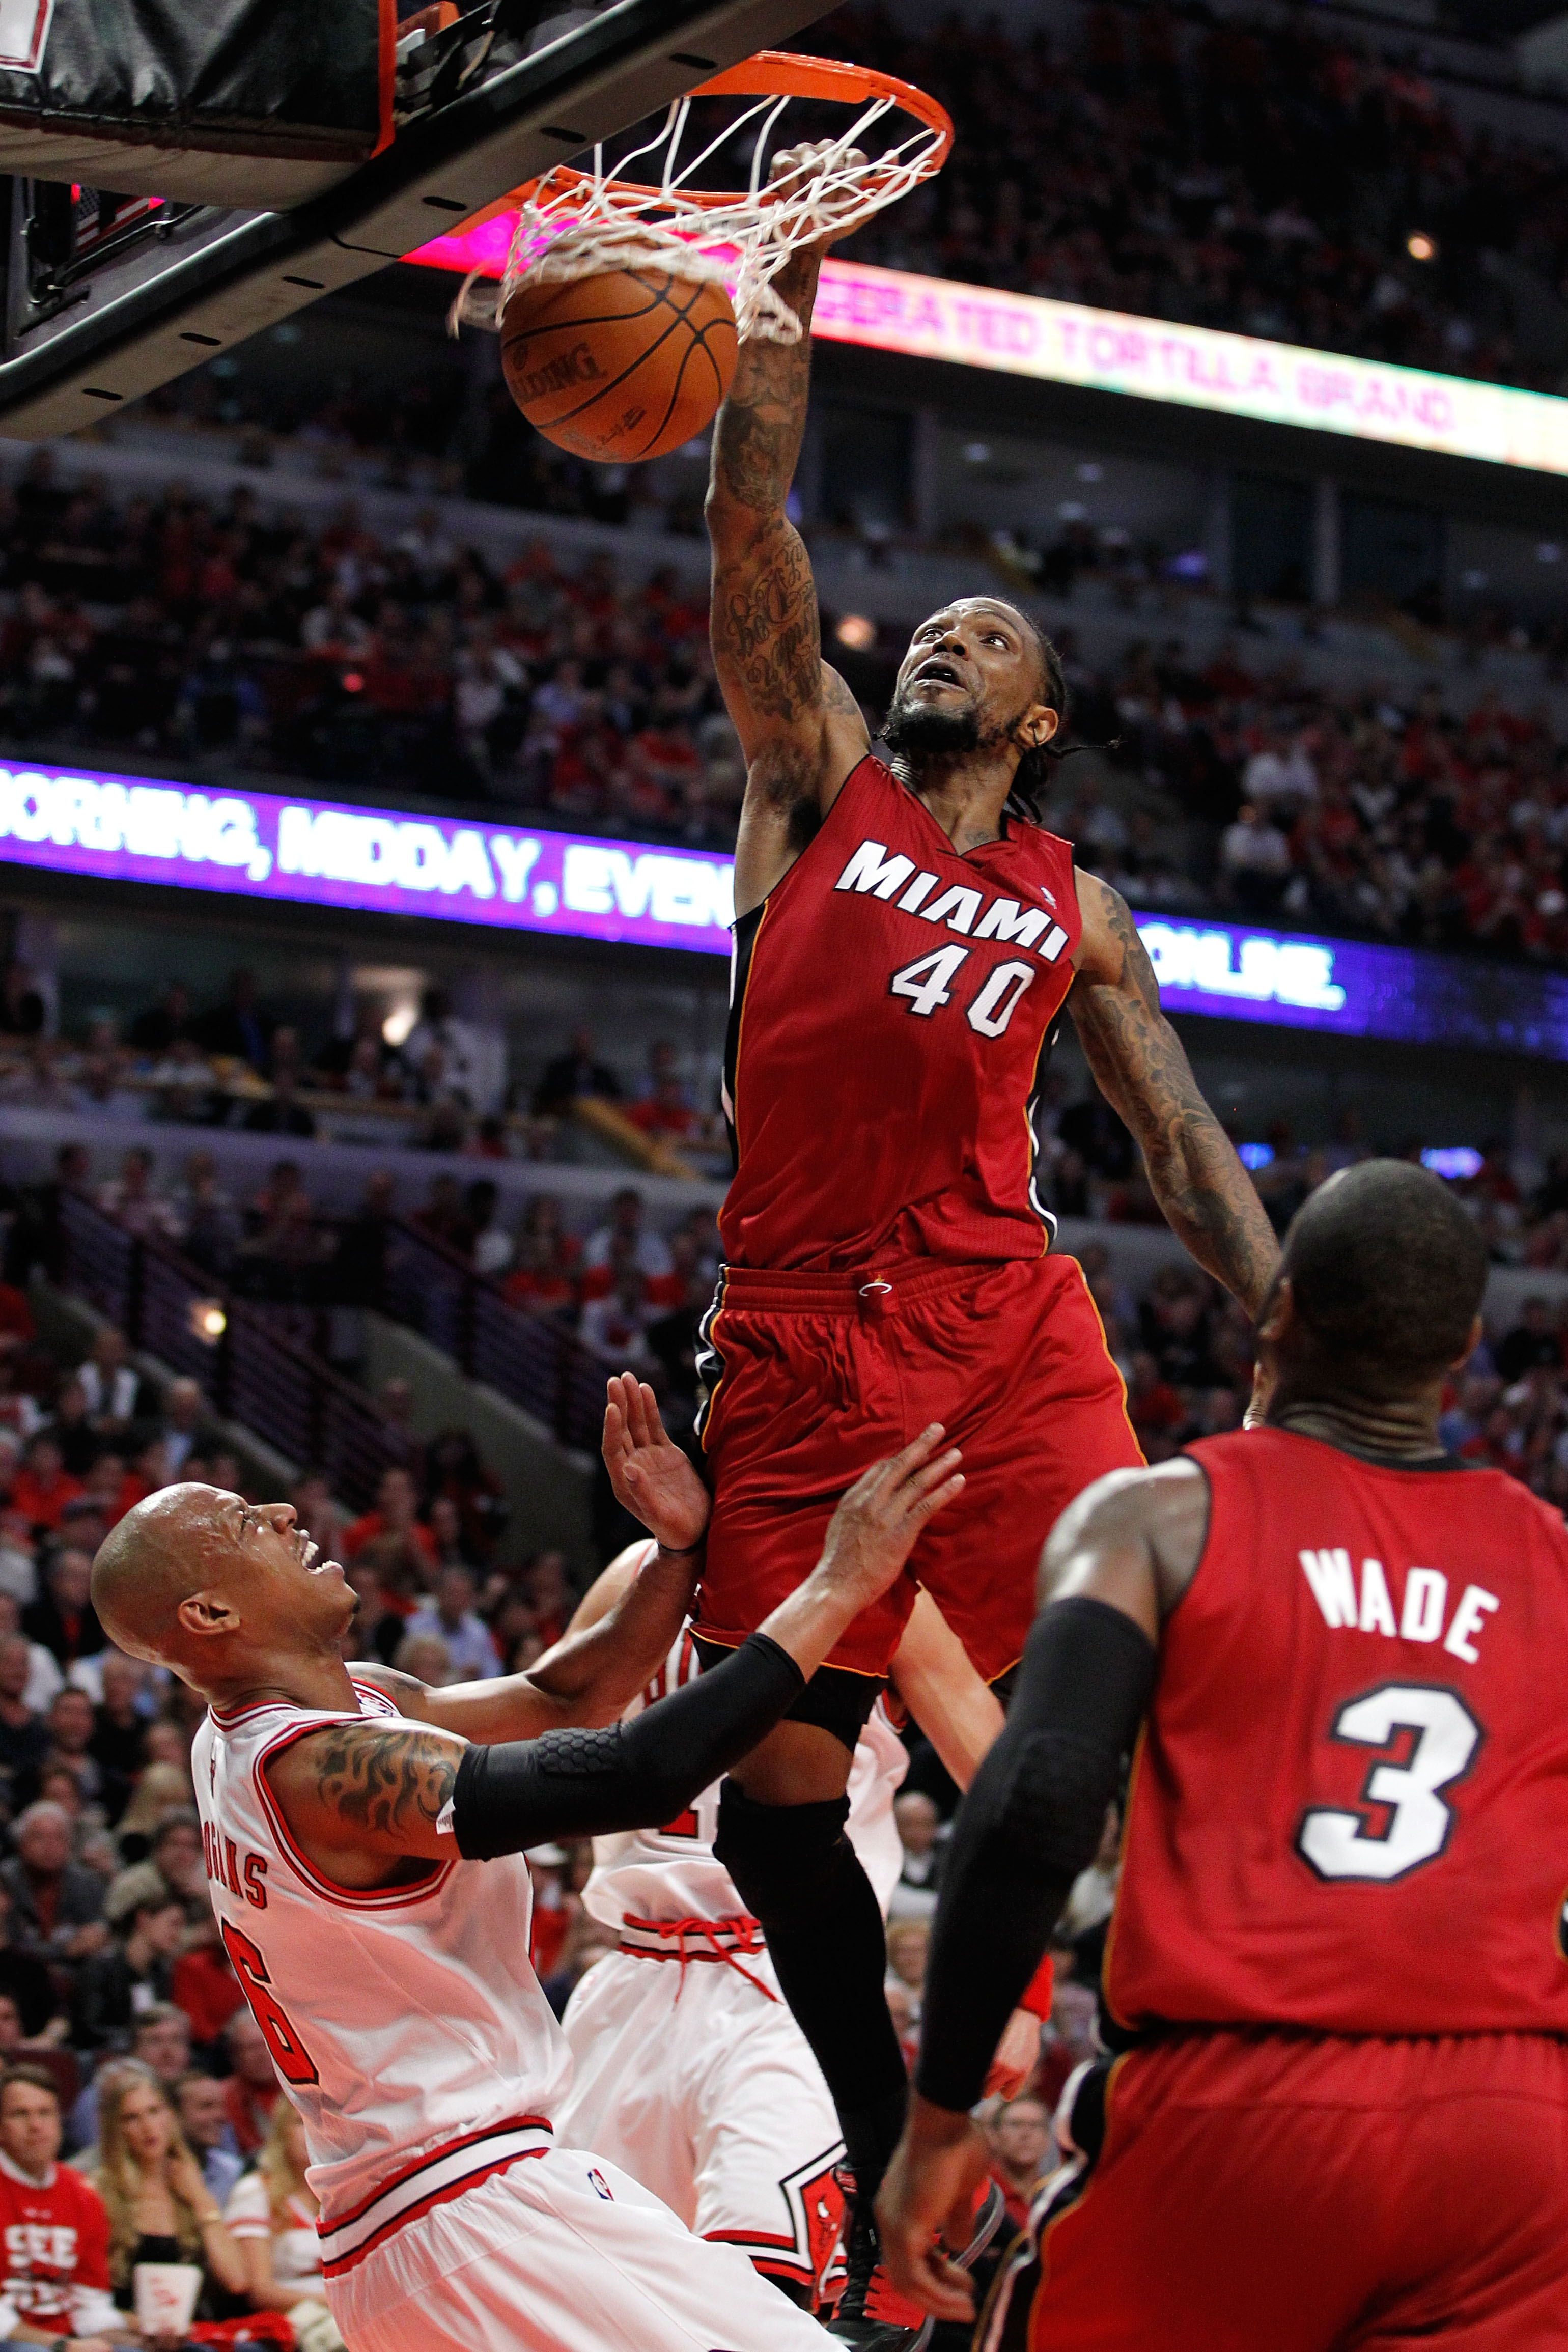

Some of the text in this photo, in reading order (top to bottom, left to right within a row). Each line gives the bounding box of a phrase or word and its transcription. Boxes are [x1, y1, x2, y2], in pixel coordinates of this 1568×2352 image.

[1056, 318, 1280, 394] TORTILLA
[1296, 362, 1453, 433] BRAND
[0, 768, 273, 882] ORNING,
[278, 805, 560, 917] MIDDAY,
[833, 839, 1070, 963] MIAMI
[889, 941, 1037, 1040] 40
[1298, 1547, 1500, 1664] WADE
[1294, 1682, 1485, 1883] 3
[221, 1918, 320, 2085] 6
[5, 2224, 78, 2270] SEE
